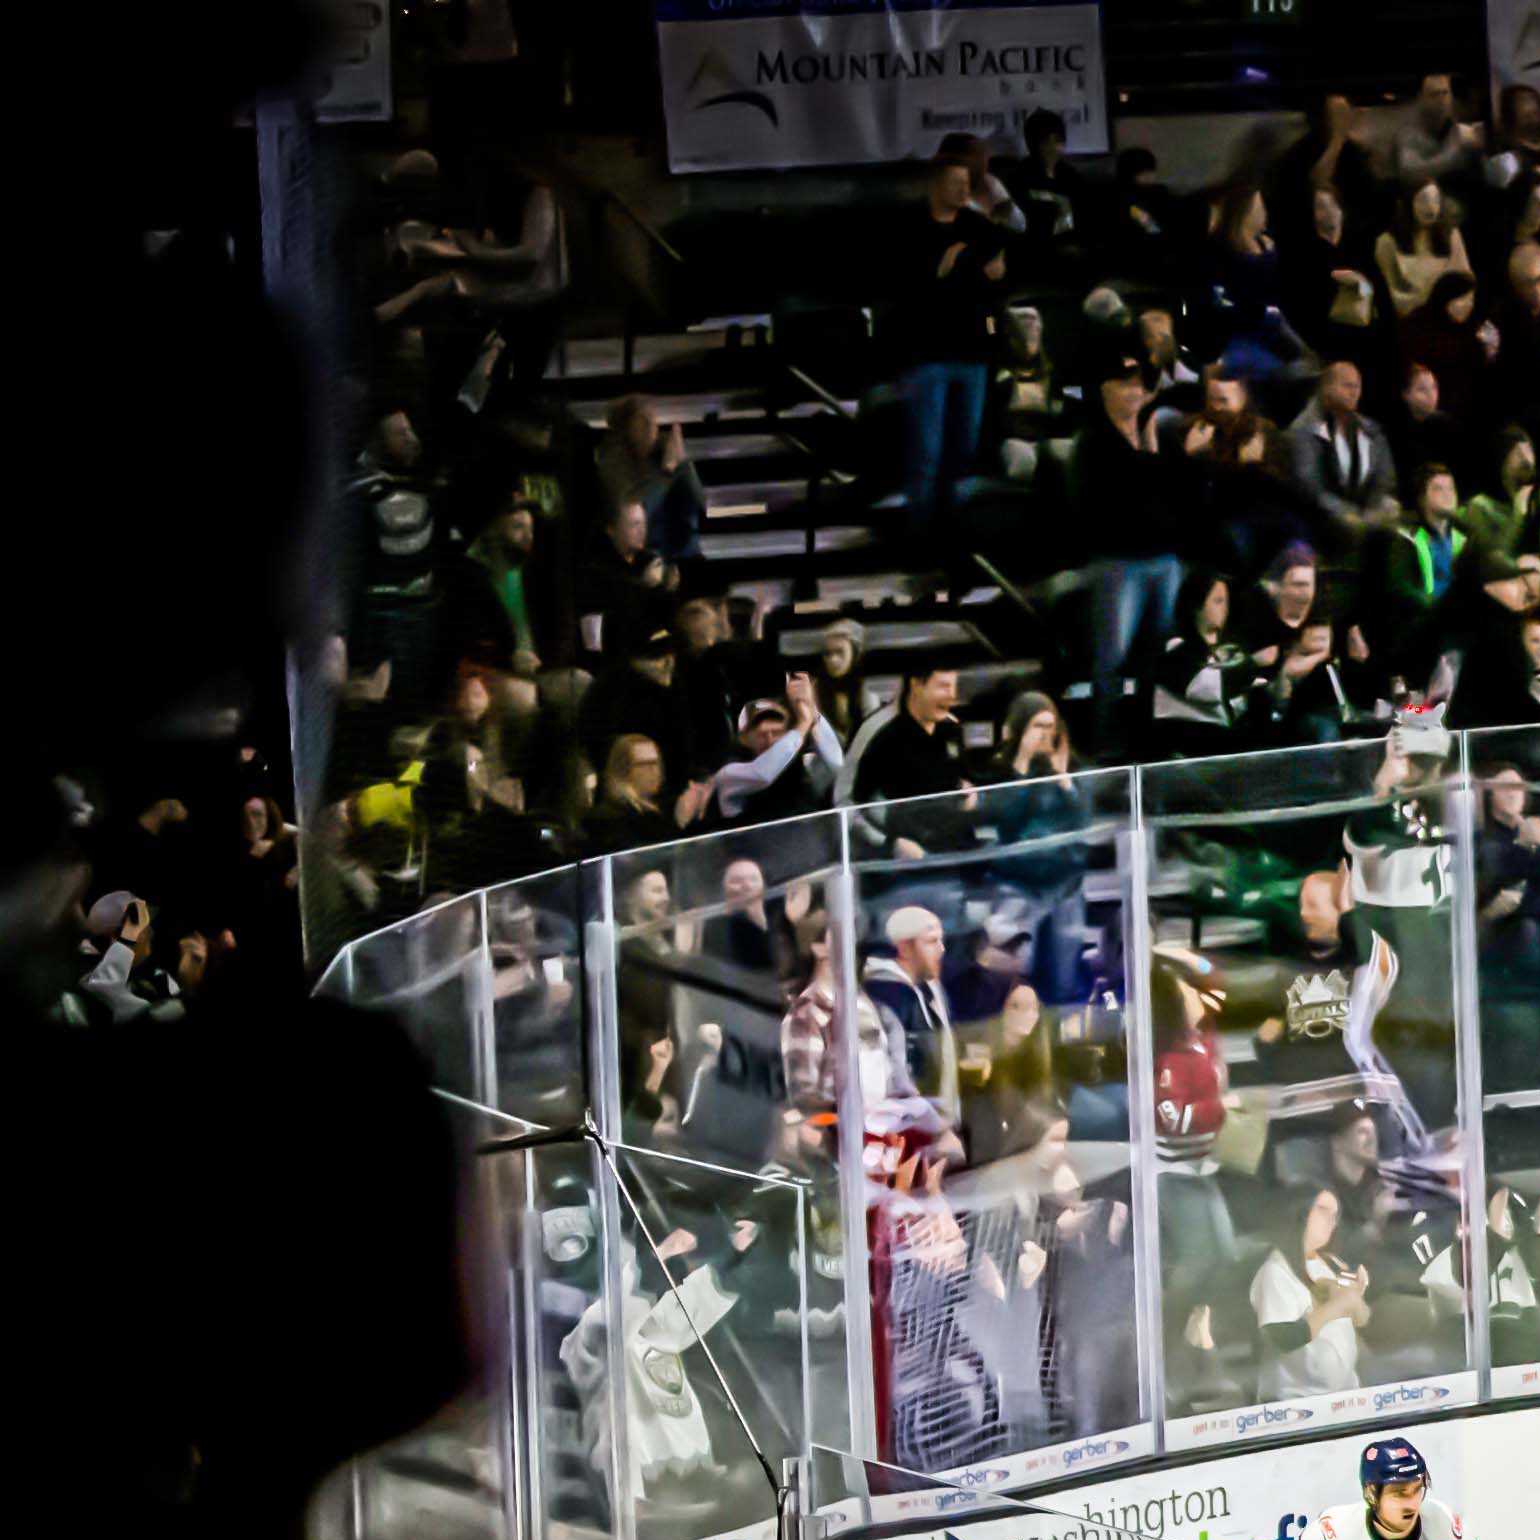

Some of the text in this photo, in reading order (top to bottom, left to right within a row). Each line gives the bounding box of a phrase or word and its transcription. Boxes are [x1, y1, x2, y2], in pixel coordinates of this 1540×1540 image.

[756, 42, 1086, 85] MOUNTAIN PACIFIC
[1373, 1385, 1428, 1410] gerber
[1236, 1405, 1292, 1434] gerber
[1063, 1440, 1109, 1468] gerber
